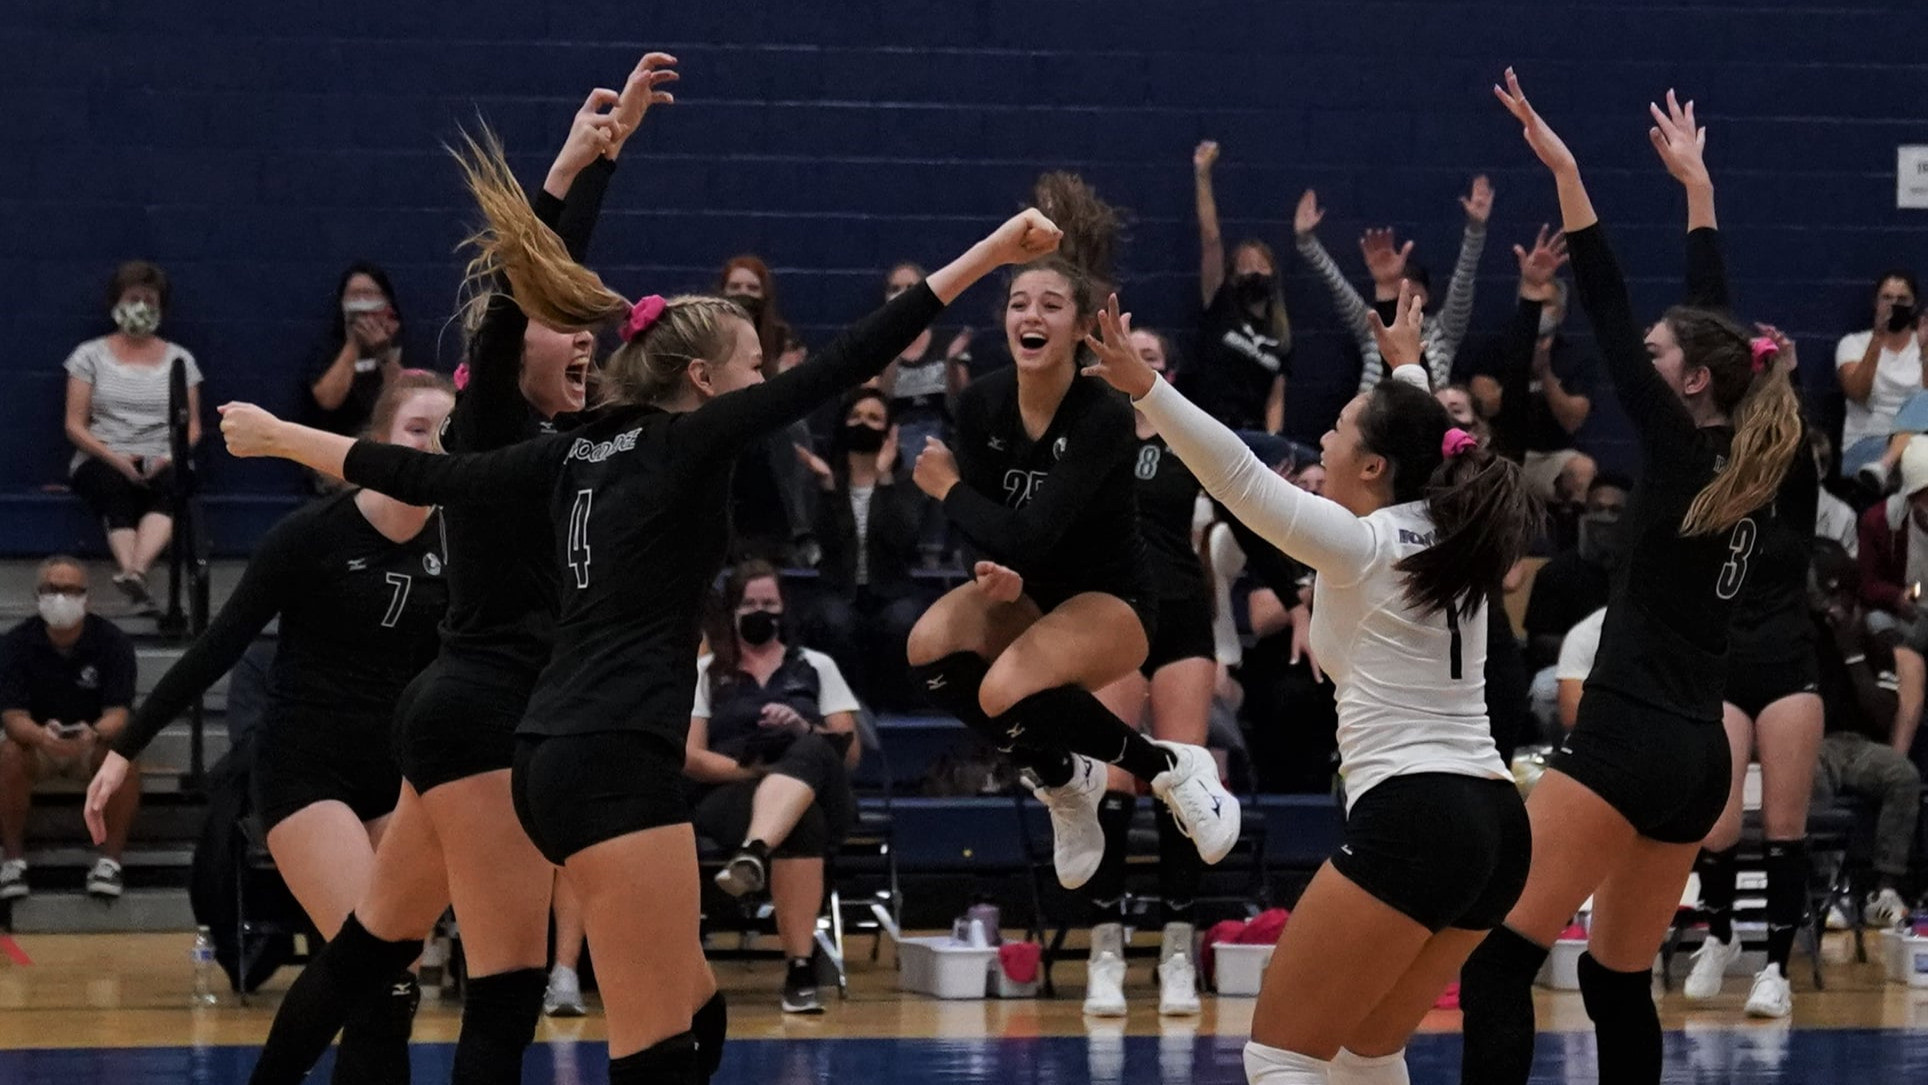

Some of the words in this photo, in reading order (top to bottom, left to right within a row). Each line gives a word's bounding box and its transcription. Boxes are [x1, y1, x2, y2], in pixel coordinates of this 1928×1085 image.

[1134, 444, 1160, 480] 8
[568, 488, 592, 589] 4
[1715, 517, 1757, 600] 3
[380, 571, 412, 628] 7
